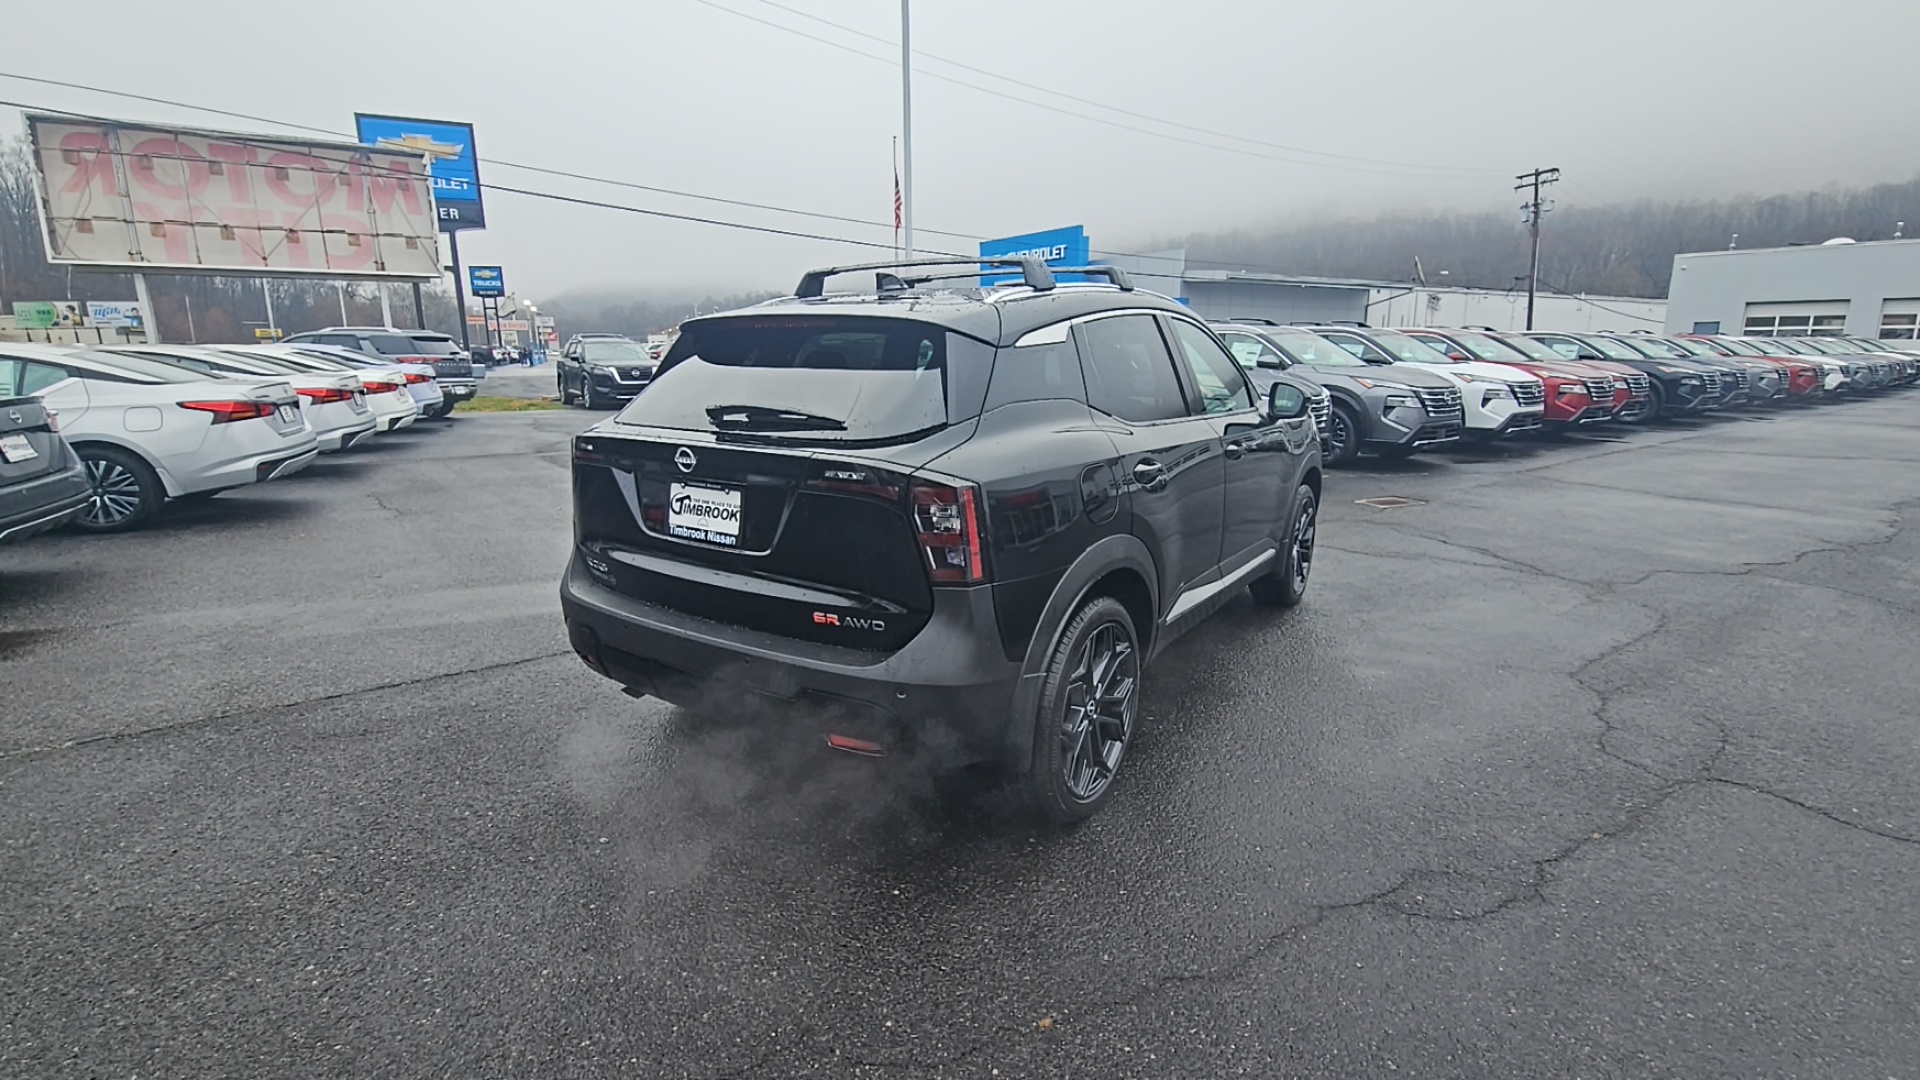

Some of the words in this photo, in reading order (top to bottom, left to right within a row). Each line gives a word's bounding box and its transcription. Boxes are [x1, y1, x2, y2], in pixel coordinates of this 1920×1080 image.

[670, 492, 741, 522] TIMBROOK
[670, 525, 706, 539] Timbrook
[707, 531, 736, 545] Nissan
[813, 611, 840, 625] SR
[843, 616, 885, 631] AWD
